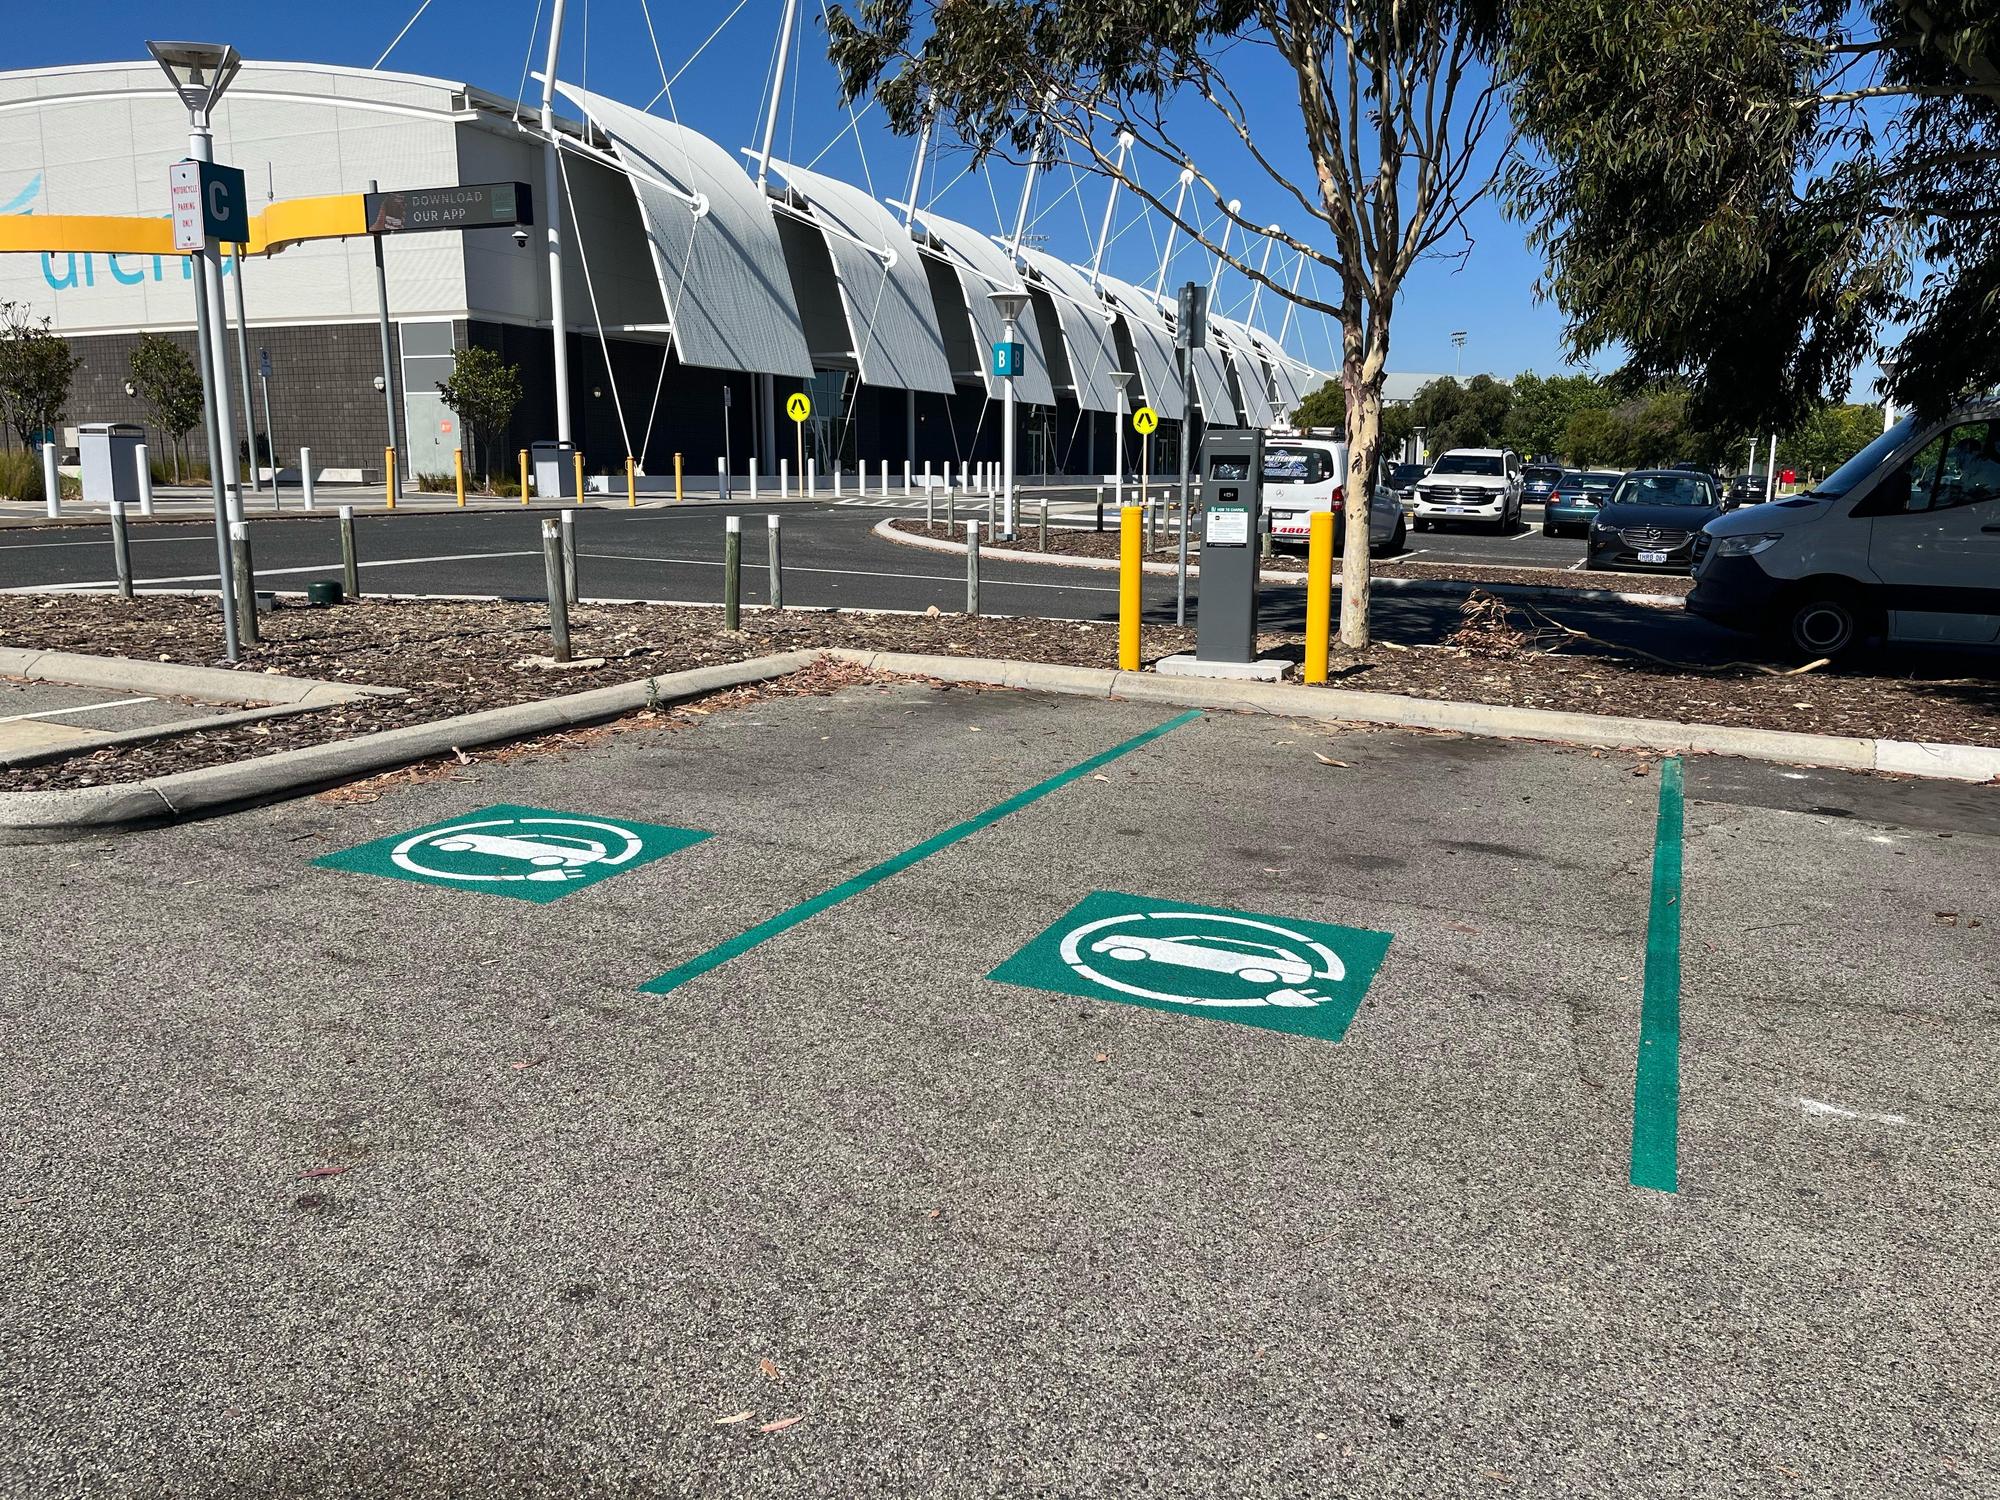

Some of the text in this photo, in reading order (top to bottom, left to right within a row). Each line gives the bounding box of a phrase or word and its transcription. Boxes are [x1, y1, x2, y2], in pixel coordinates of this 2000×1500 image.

[173, 185, 198, 194] MOTORCYCLE
[177, 202, 196, 211] PARKING
[208, 180, 230, 222] C
[412, 191, 483, 207] DOWNLOAD
[413, 208, 466, 222] OUR APP
[182, 219, 193, 227] ONLY
[998, 350, 1006, 368] B
[1014, 350, 1021, 368] B
